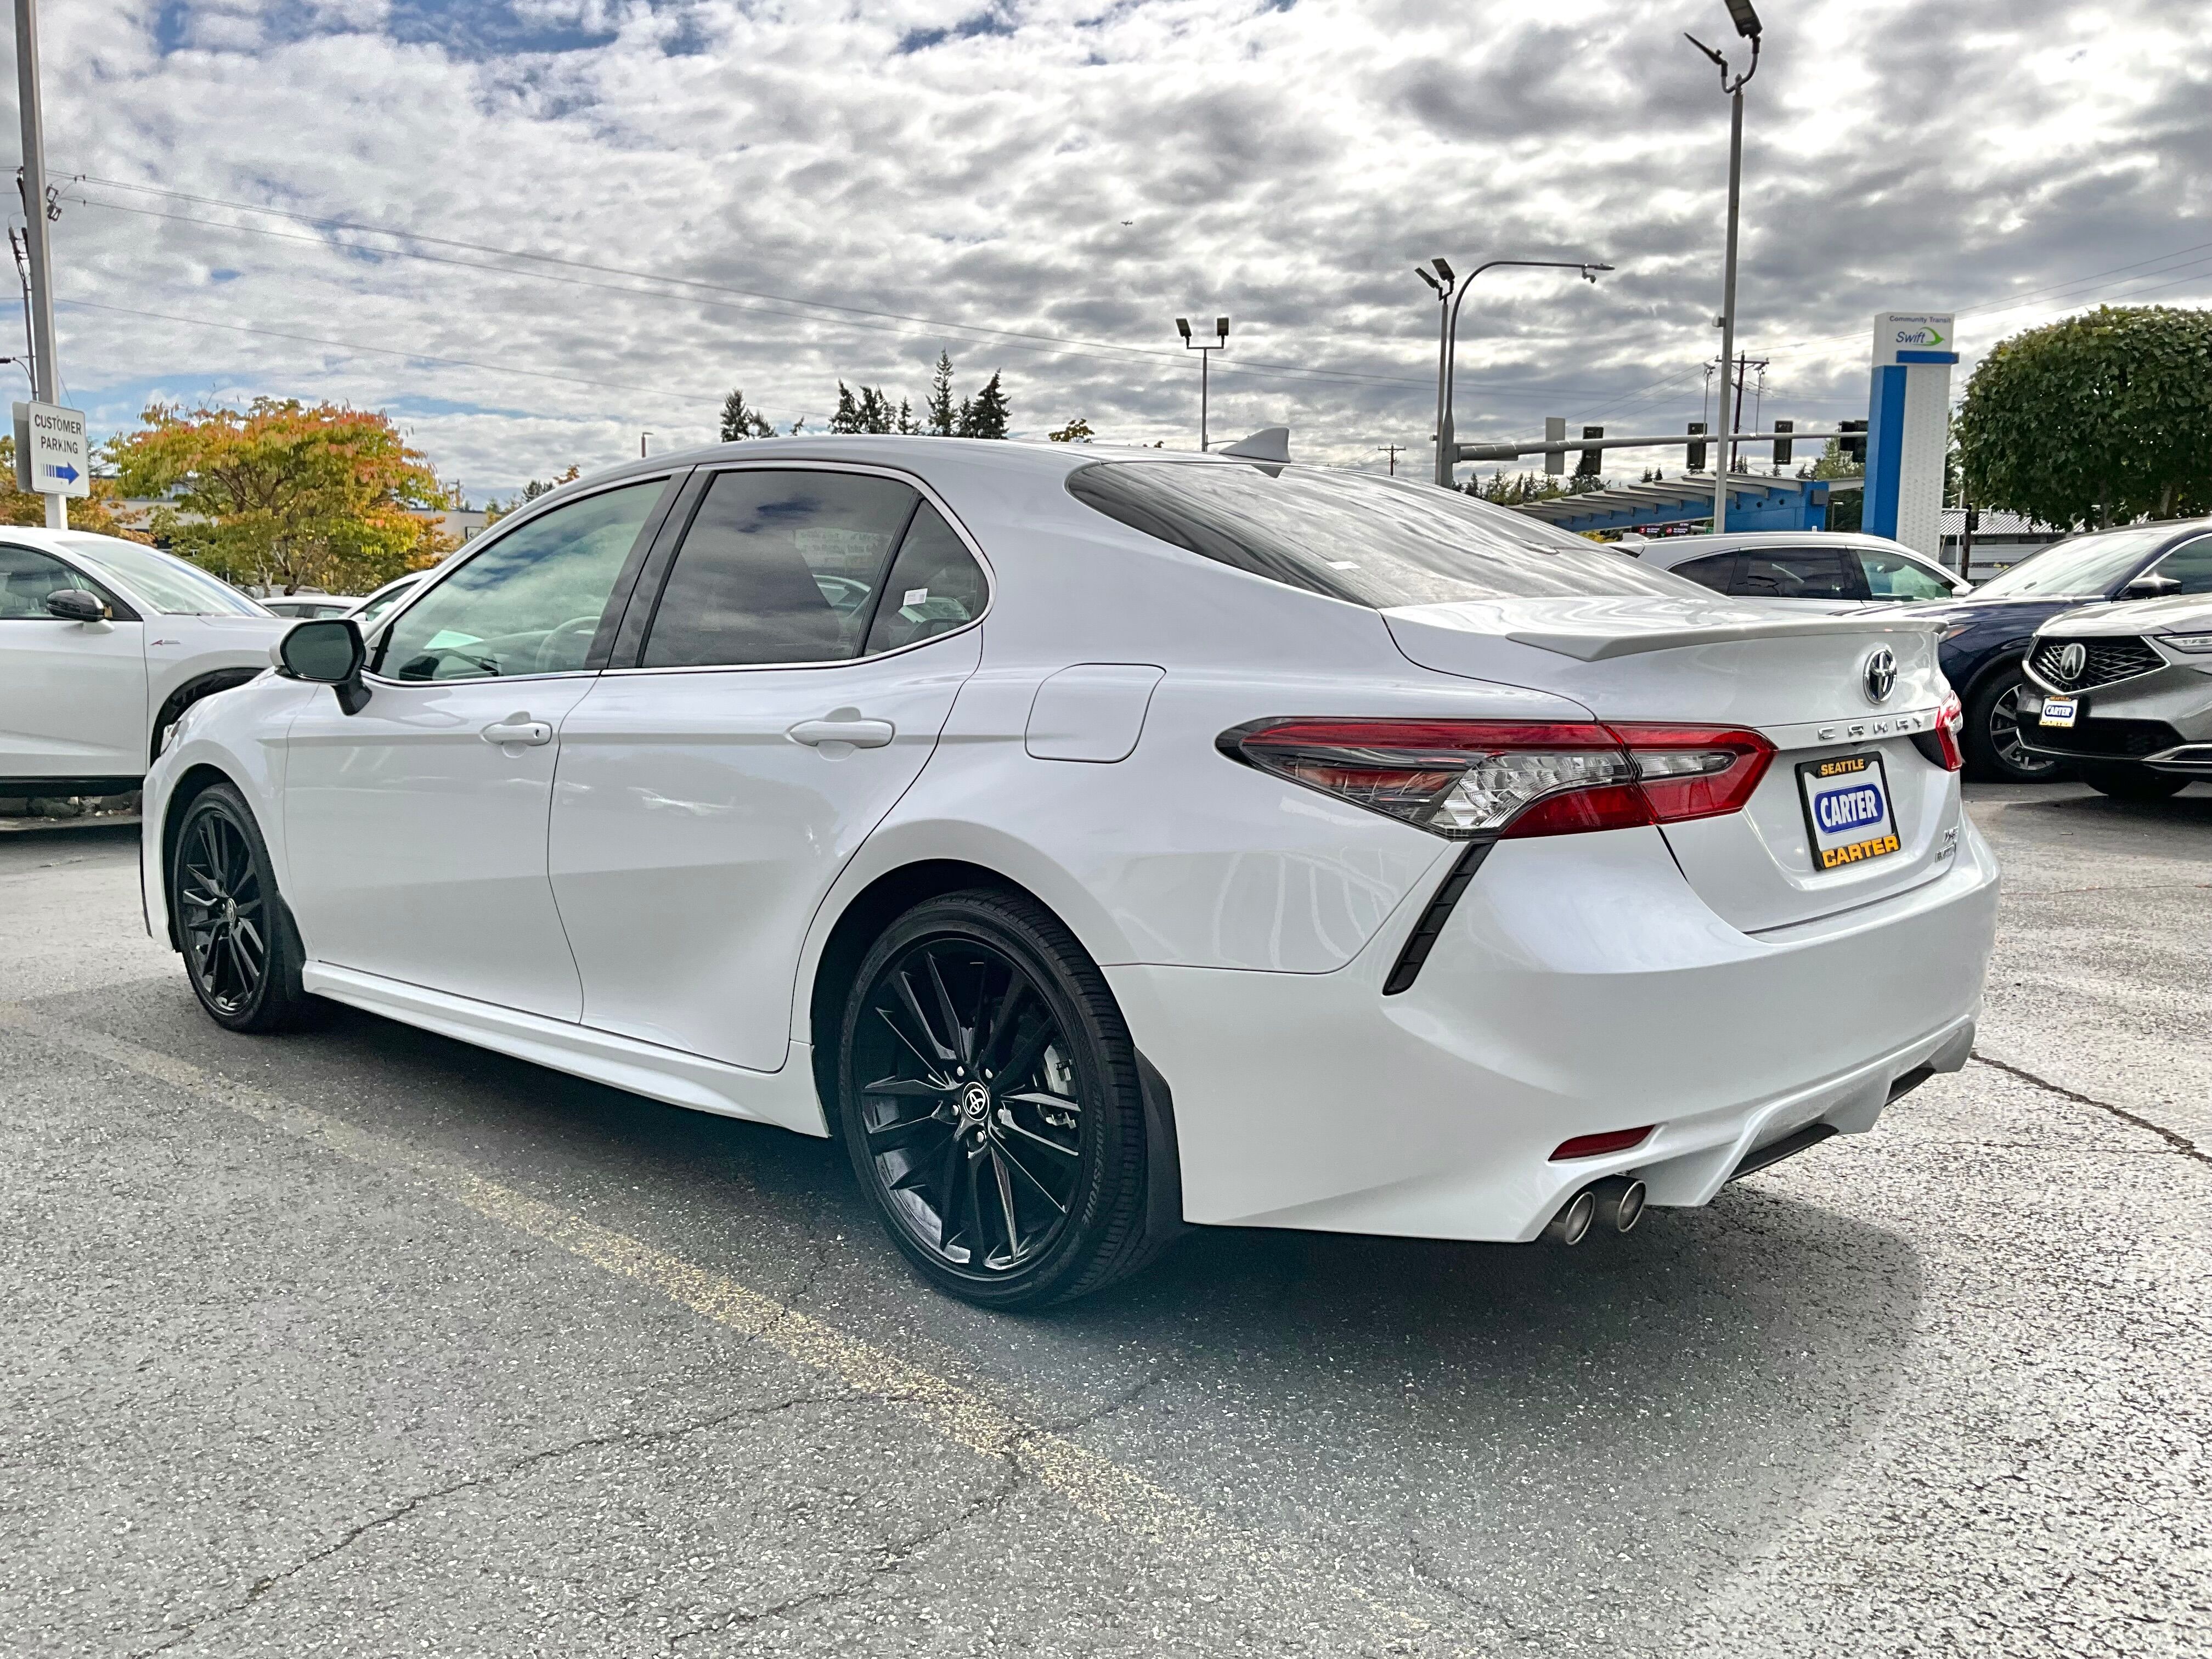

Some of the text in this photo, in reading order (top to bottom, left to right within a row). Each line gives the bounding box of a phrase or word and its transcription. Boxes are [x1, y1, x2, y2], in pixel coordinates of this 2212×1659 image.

[1889, 315, 1927, 324] Community
[1896, 331, 1925, 343] Swift
[35, 414, 82, 435] CUSTOMER
[41, 436, 78, 454] PARKING
[2046, 706, 2072, 716] CARTER
[1818, 716, 1923, 740] CAMRY
[1820, 758, 1865, 776] SEATTLE
[1820, 789, 1878, 827] CARTER
[1822, 835, 1899, 868] CARTER
